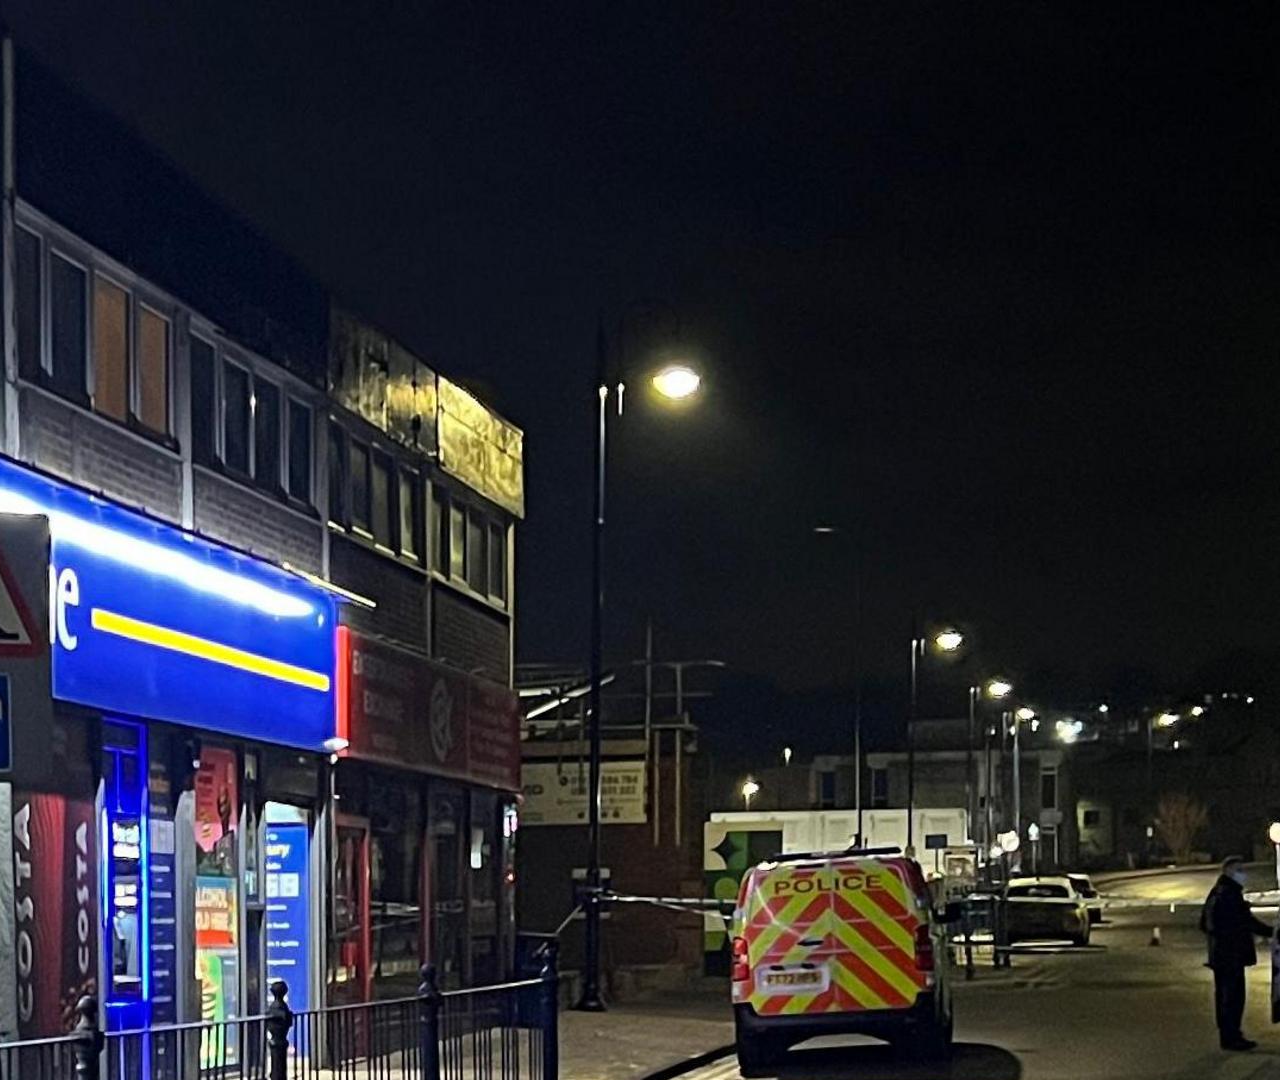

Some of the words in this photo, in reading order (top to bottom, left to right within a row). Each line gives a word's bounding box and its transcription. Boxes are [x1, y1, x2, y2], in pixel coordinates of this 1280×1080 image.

[14, 802, 34, 1022] COSTA
[76, 821, 89, 975] COSTA
[774, 875, 881, 895] POLICE
